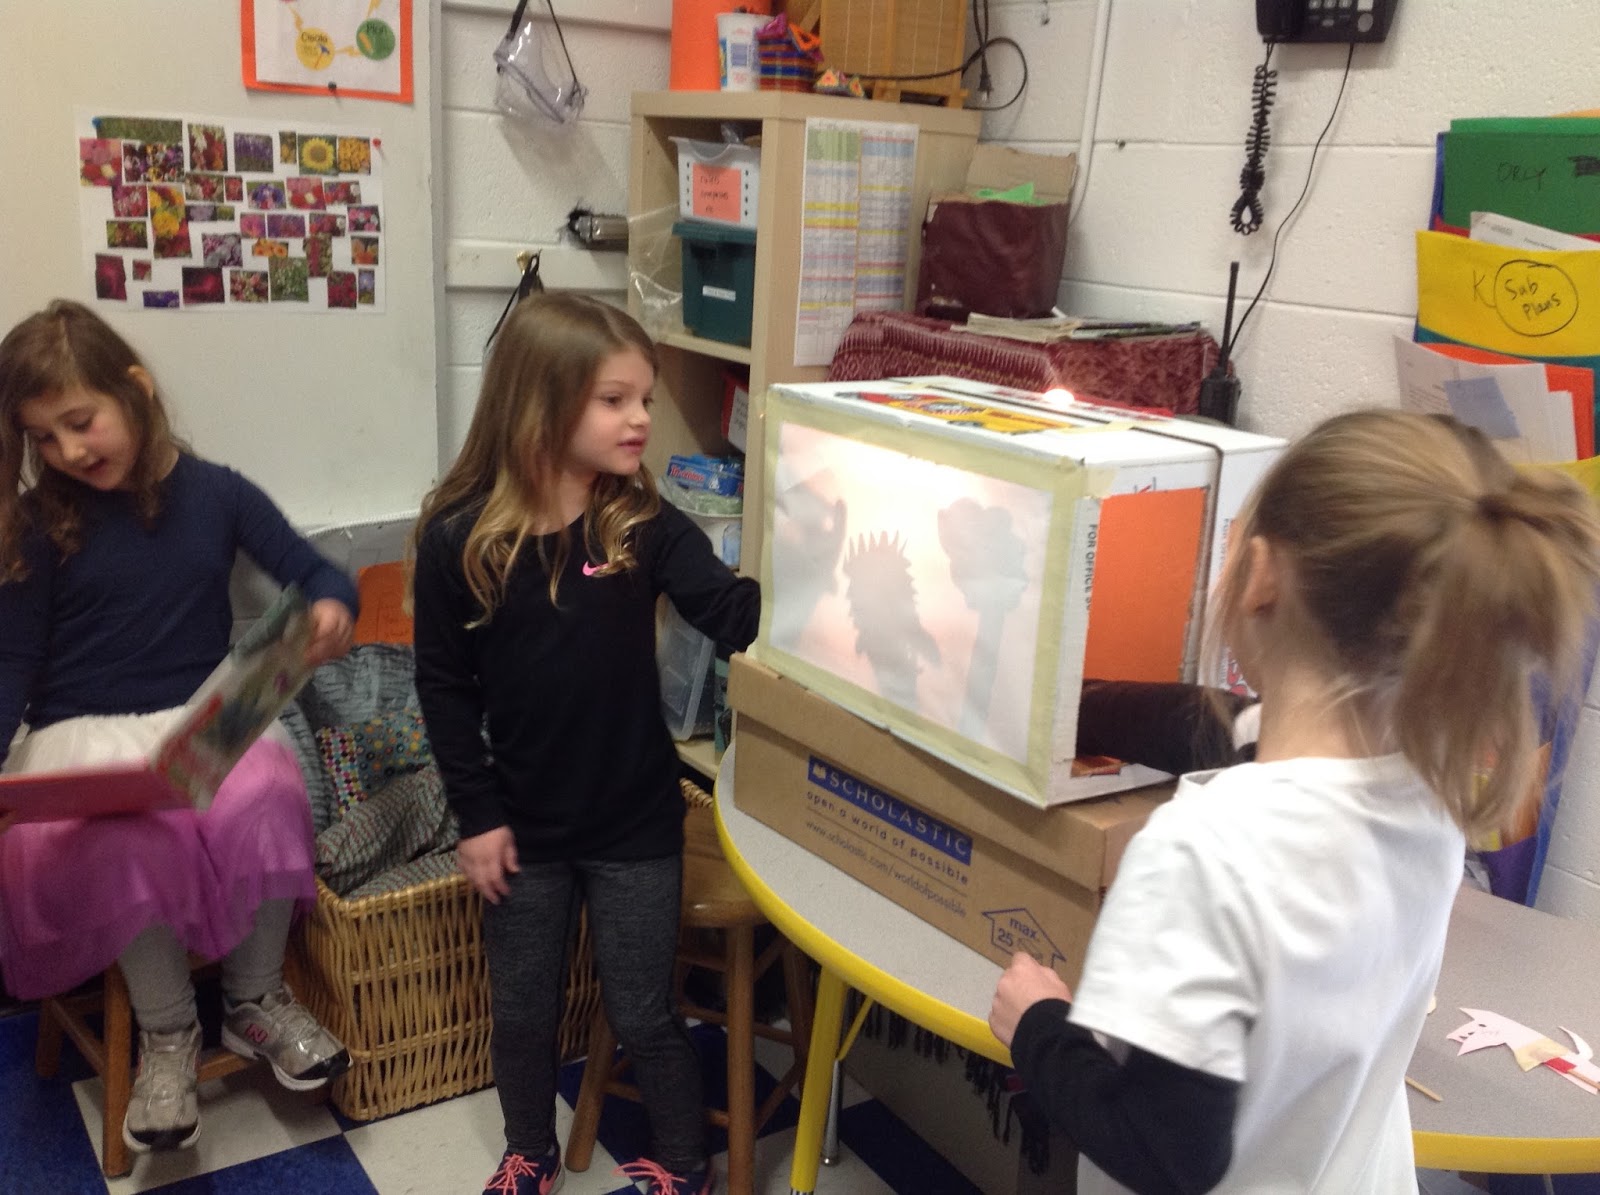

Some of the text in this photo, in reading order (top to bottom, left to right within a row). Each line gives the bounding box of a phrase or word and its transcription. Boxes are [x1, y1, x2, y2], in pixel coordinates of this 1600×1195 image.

[1504, 277, 1538, 300] Sub
[1087, 523, 1098, 549] FOR
[1084, 552, 1096, 594] OFFICE
[829, 772, 966, 856] SCHOLASTIC
[807, 789, 969, 885] open a world of possible
[998, 927, 1014, 947] 25
